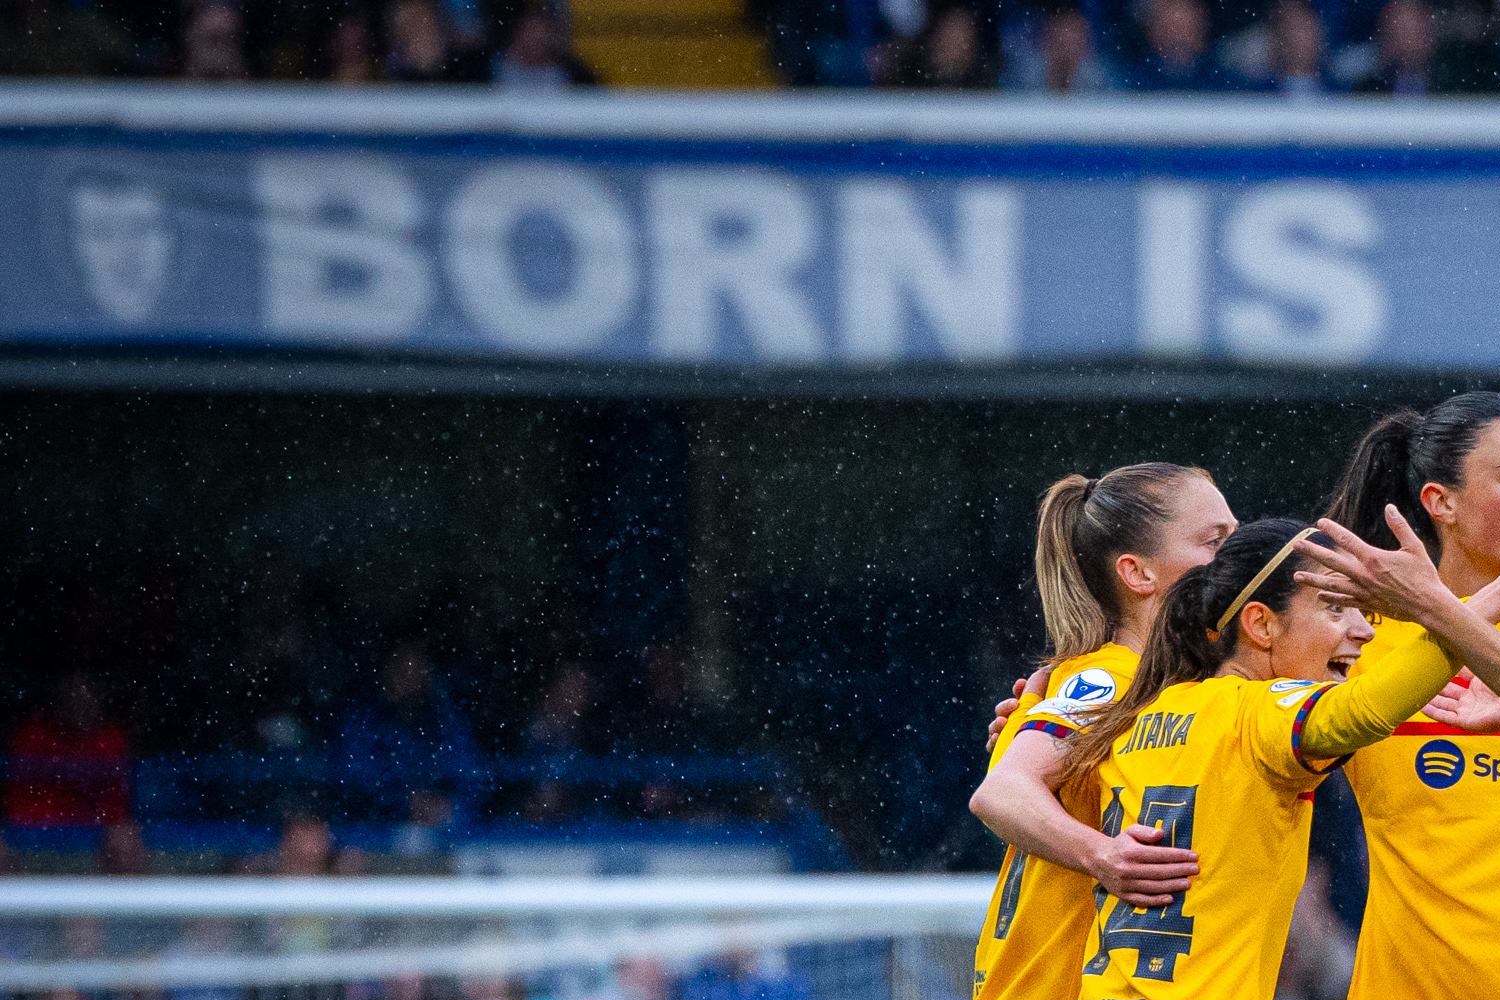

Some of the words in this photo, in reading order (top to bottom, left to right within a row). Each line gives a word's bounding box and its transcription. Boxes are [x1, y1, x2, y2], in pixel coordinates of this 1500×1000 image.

[254, 153, 1022, 362] BORN
[1134, 178, 1388, 366] IS
[1117, 711, 1197, 755] ITANA
